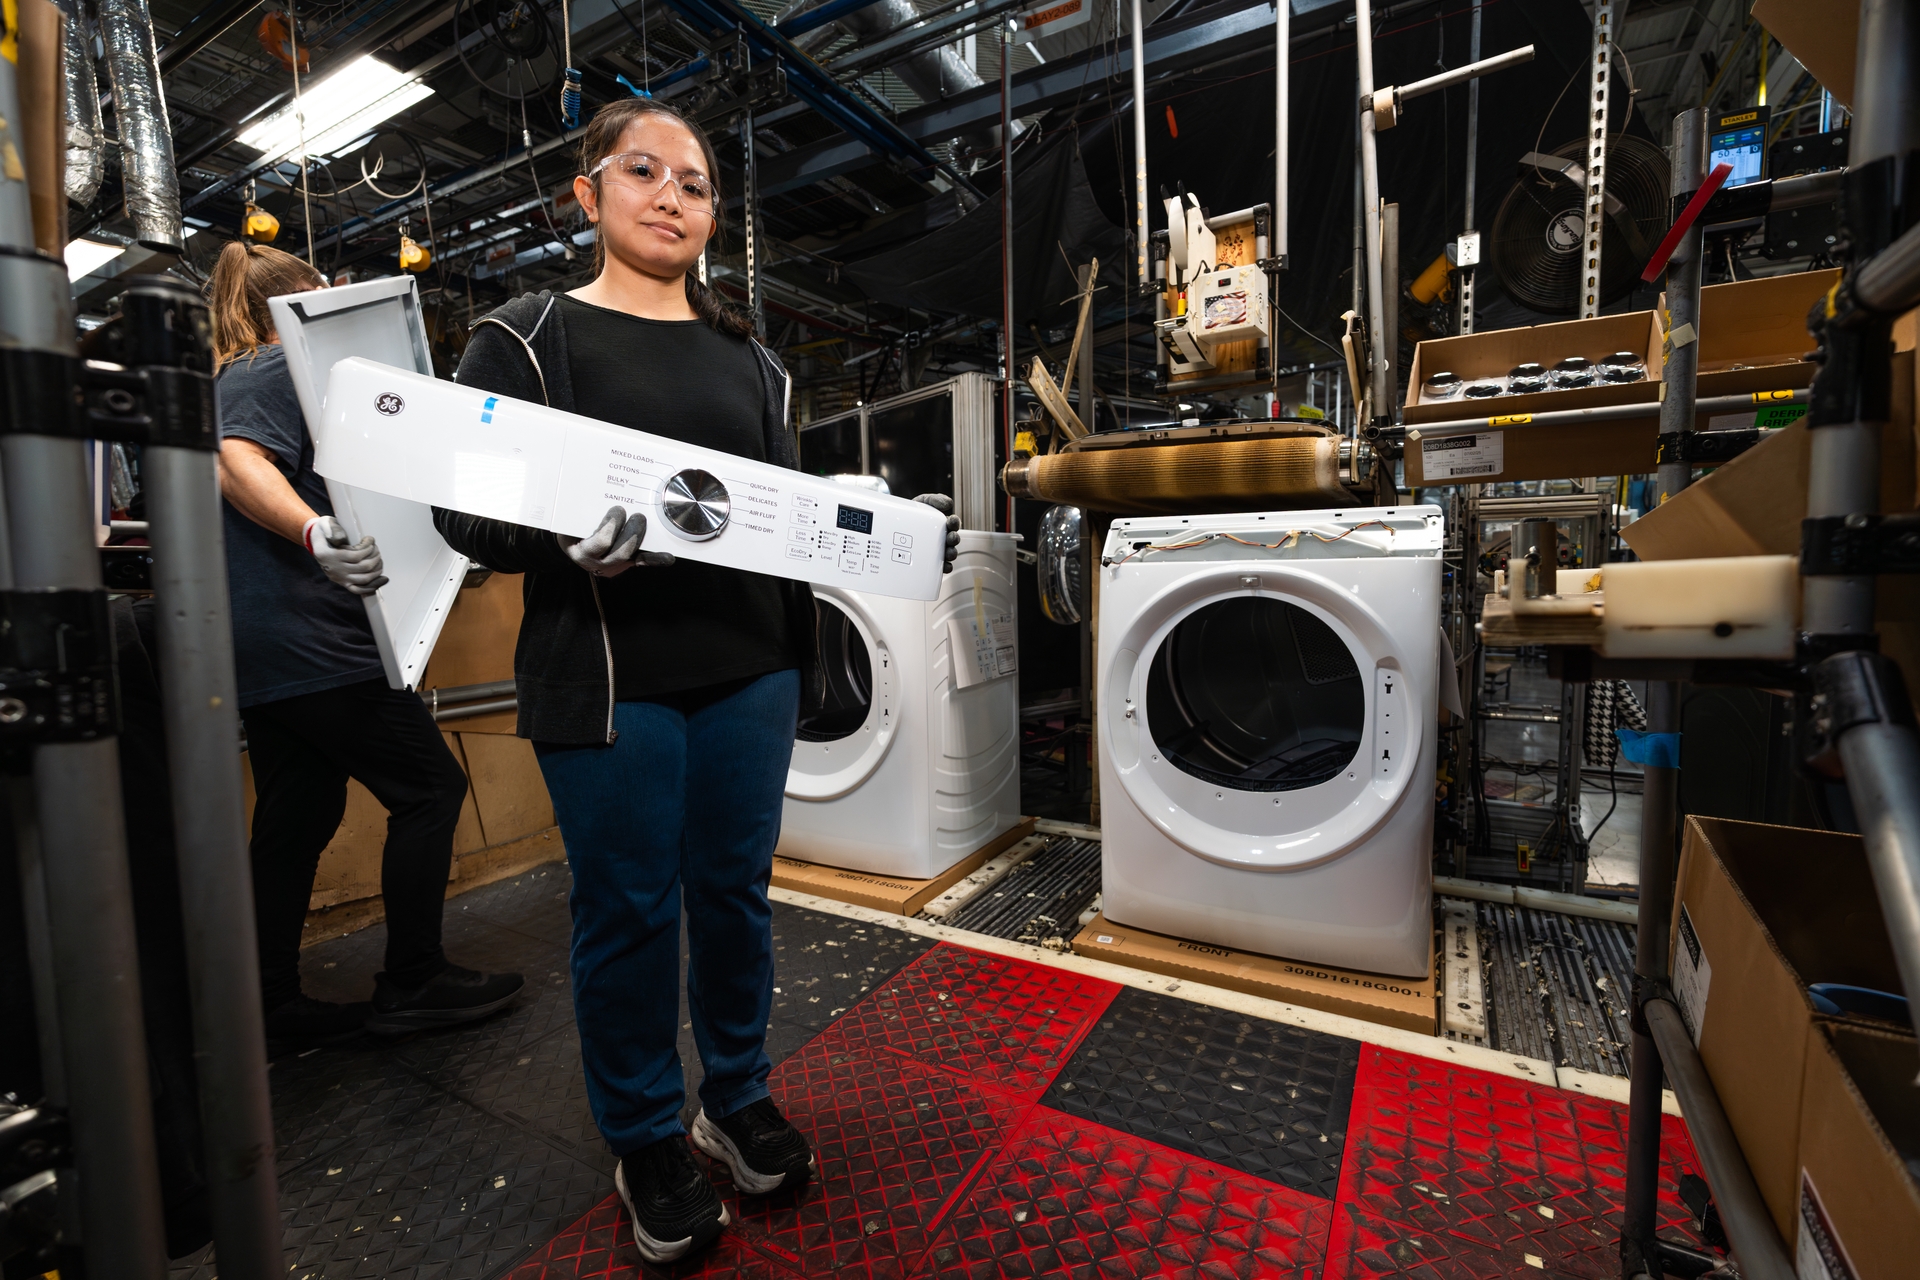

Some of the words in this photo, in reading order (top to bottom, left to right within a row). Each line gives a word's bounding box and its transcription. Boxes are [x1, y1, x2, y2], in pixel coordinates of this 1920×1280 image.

[1026, 1, 1081, 26] 01-AY2-089
[1723, 113, 1754, 123] STANLEY
[611, 449, 632, 459] MIXED
[633, 454, 654, 464] LOADS
[609, 463, 640, 474] COTTONS
[607, 475, 629, 484] BULKY
[750, 483, 766, 492] QUICK
[766, 486, 779, 494] DRY
[604, 493, 635, 504] SANITIZE
[748, 496, 778, 507] DELICATES
[796, 495, 813, 504] Wrinkle
[749, 509, 759, 517] AIR
[760, 512, 776, 520] FLUFF
[745, 523, 762, 532] TIMED
[762, 526, 774, 534] DRY
[791, 547, 807, 556] EcoDry
[776, 859, 811, 869] FRONT
[835, 872, 914, 891] 308D1618G001
[1177, 942, 1233, 958] FRONT
[1283, 965, 1421, 998] 308D1618G001
